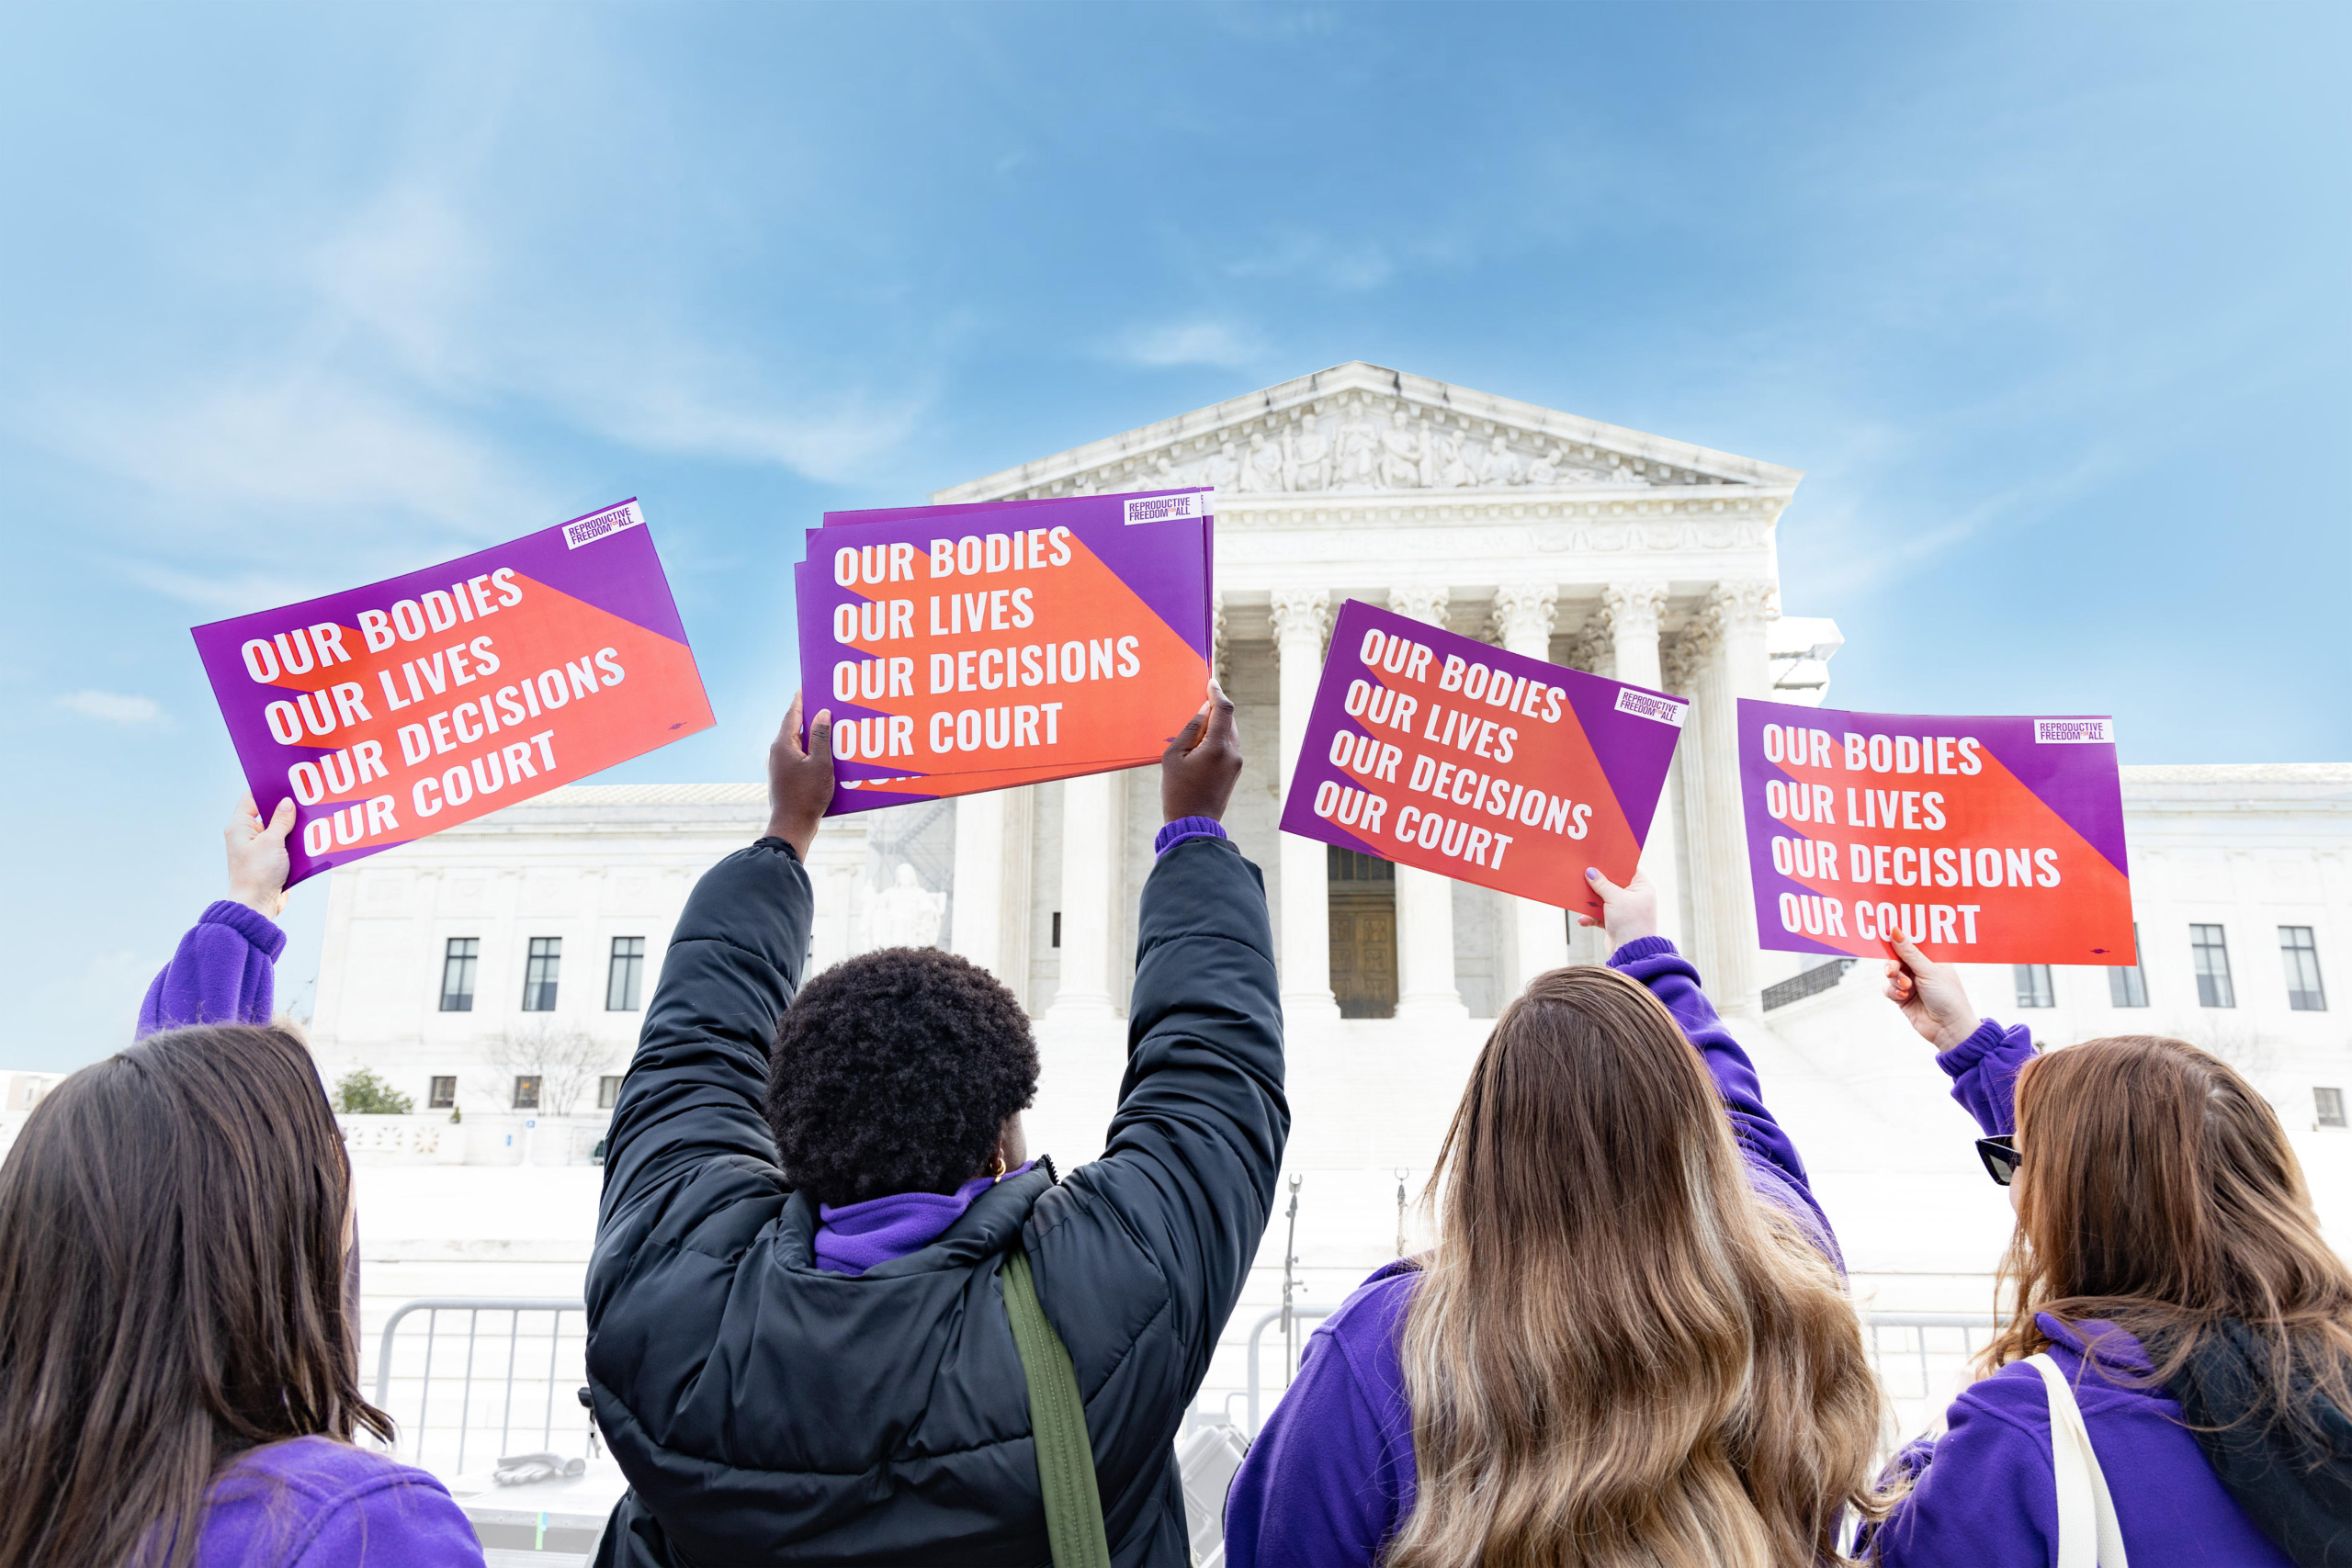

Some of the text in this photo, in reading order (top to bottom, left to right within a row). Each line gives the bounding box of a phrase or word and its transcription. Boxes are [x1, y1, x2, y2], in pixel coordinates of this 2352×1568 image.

[569, 507, 631, 536] REPRODUCTIVE
[571, 523, 612, 545] FREEDOM
[618, 515, 634, 528] ALL
[1129, 497, 1191, 512] REPRODUCTIVE
[1129, 508, 1169, 521] FREEDOM
[1175, 506, 1191, 515] ALL
[833, 525, 1072, 587] OUR BODIES
[242, 567, 524, 683] OUR BODIES
[832, 587, 1035, 644] OUR LIVES
[264, 635, 501, 746] OUR LIVES
[832, 635, 1141, 702] OUR DECISIONS
[1359, 628, 1566, 724] OUR BODIES
[288, 647, 626, 807] OUR DECISIONS
[1344, 679, 1519, 764] OUR LIVES
[1620, 700, 1656, 716] FREEDOM
[1660, 711, 1674, 722] ALL
[1623, 692, 1678, 714] REPRODUCTIVE
[2040, 722, 2103, 731] REPRODUCTIVE
[832, 703, 1063, 761] OUR COURT
[1762, 723, 1983, 776] OUR BODIES
[2041, 731, 2081, 739] FREEDOM
[2088, 730, 2104, 739] ALL
[303, 729, 557, 858] OUR COURT
[1329, 729, 1593, 840] OUR DECISIONS
[1765, 779, 1947, 831] OUR LIVES
[1313, 780, 1514, 871] OUR COURT
[1770, 835, 2062, 888] OUR DECISIONS
[1778, 892, 1981, 944] OUR COURT
